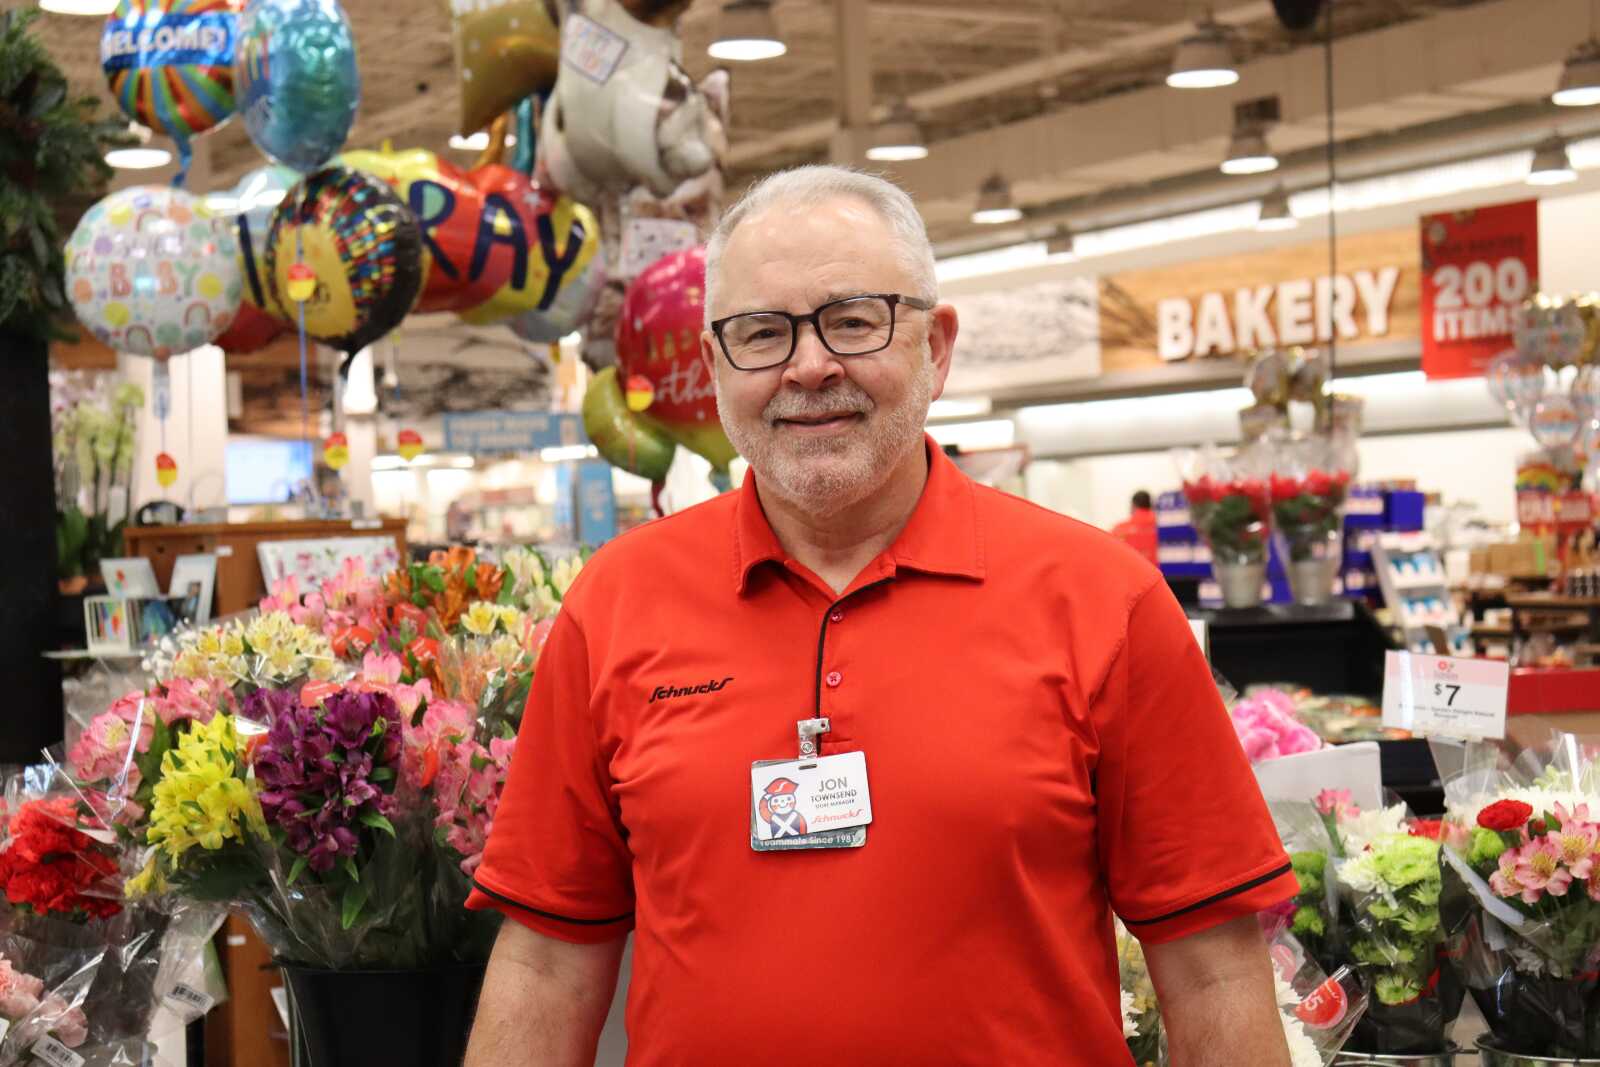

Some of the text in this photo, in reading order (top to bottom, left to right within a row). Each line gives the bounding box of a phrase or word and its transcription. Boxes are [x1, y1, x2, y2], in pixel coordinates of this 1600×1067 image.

[1432, 258, 1528, 308] 200
[1157, 266, 1400, 362] BAKERY
[648, 677, 735, 704] Schnucks
[810, 789, 857, 804] TOWNSEND
[819, 777, 847, 792] JON
